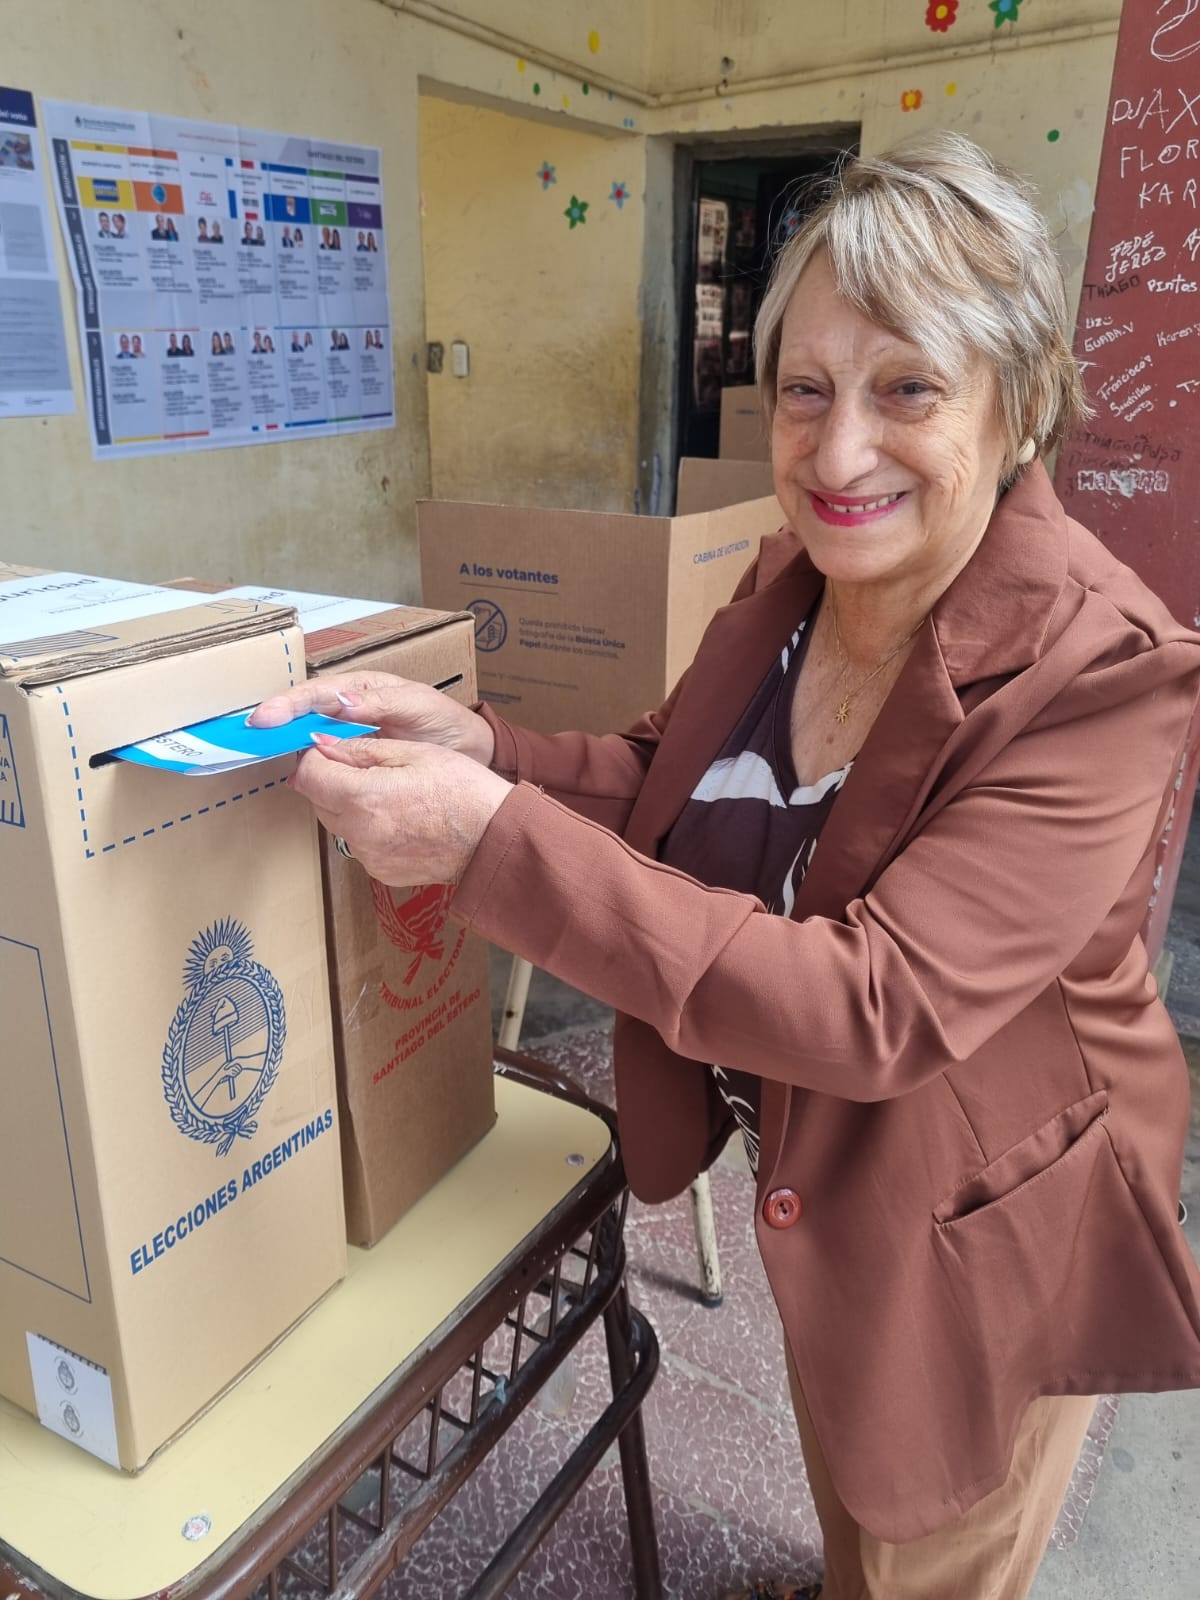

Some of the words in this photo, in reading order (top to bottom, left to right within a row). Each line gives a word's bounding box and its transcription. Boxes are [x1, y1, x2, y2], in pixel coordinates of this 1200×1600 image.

[459, 563, 470, 575] A
[473, 563, 493, 577] los
[496, 567, 559, 585] votantes
[379, 981, 425, 1011] TRIBUNAL
[427, 927, 467, 1001] ELECTORA
[372, 1036, 425, 1086] SANTIAGO
[427, 1021, 446, 1041] DEL
[447, 988, 482, 1025] ESTERO
[395, 1002, 448, 1051] PROVINCIA
[449, 989, 462, 1007] DE
[129, 1179, 238, 1276] ELECCIONES
[241, 1108, 334, 1194] ARGENTINAS
